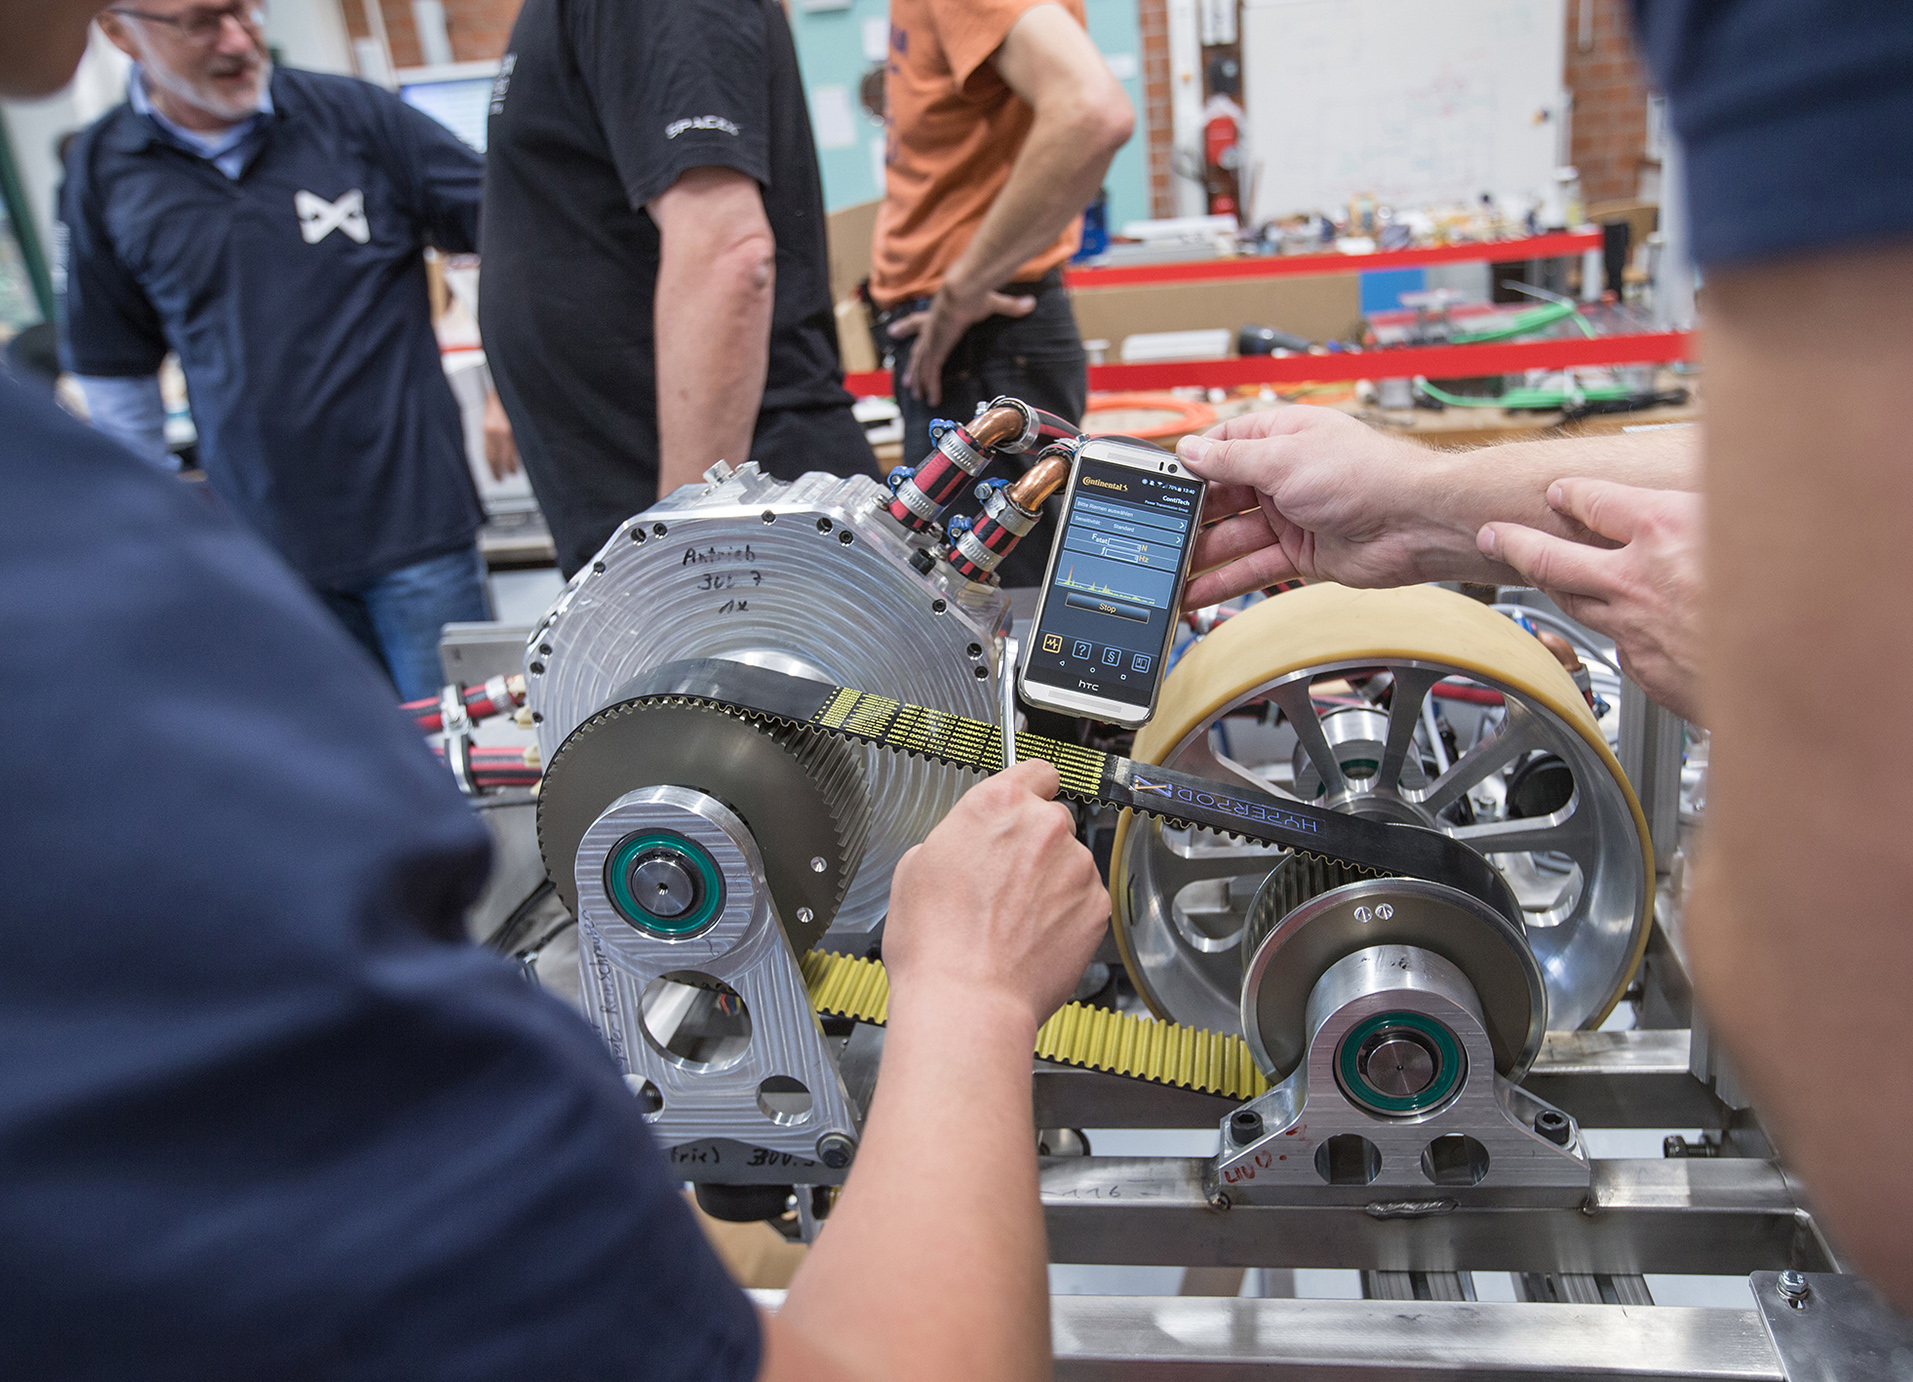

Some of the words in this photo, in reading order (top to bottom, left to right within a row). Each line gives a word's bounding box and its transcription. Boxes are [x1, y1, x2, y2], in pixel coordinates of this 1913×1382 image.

[1082, 476, 1123, 491] Continental
[1162, 495, 1191, 506] ContiTech
[1139, 555, 1149, 563] Hz
[1099, 602, 1117, 614] Stop
[1178, 789, 1317, 832] HYPERPOD
